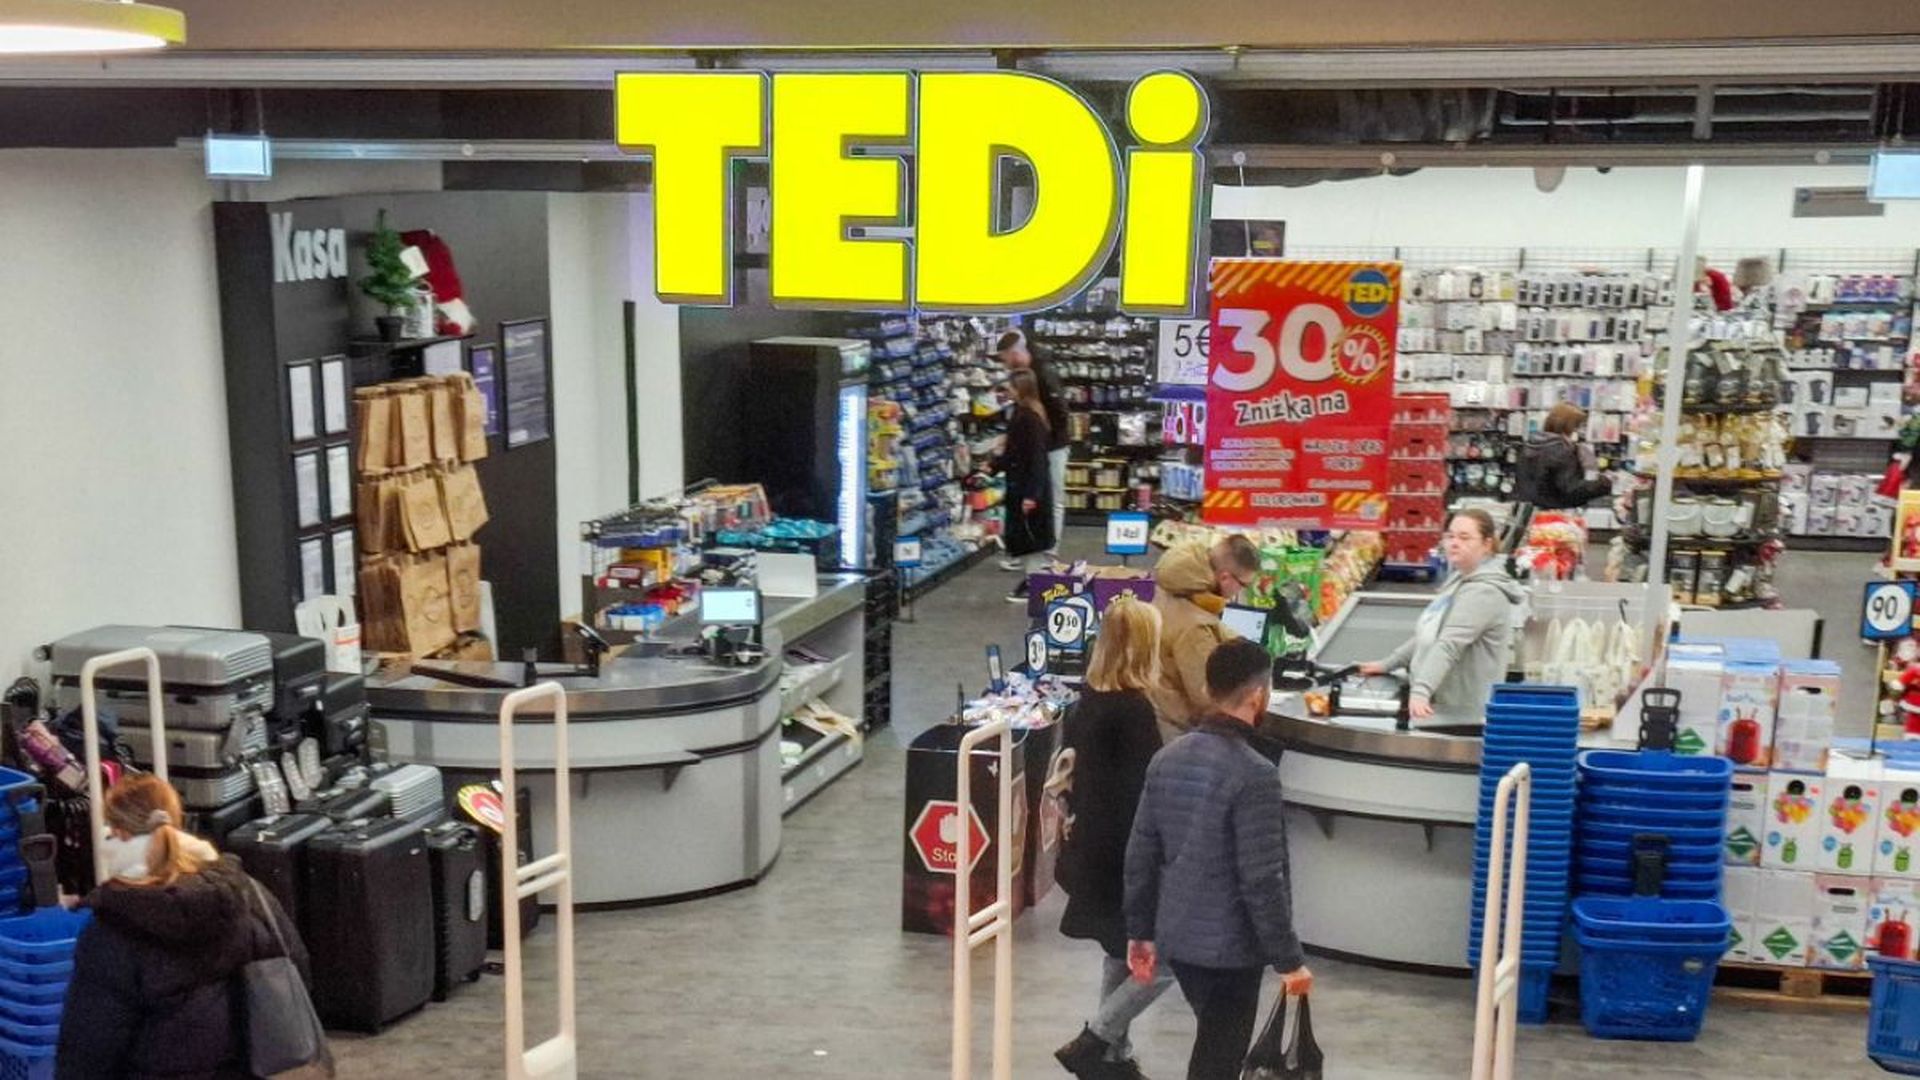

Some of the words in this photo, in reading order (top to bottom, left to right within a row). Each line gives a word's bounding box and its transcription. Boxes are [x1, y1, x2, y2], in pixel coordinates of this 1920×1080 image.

[614, 71, 1207, 309] TEDi
[271, 211, 348, 282] Kasa
[1212, 303, 1344, 391] 30
[1320, 392, 1348, 413] na
[1872, 595, 1898, 621] 90
[931, 847, 957, 862] Sto
